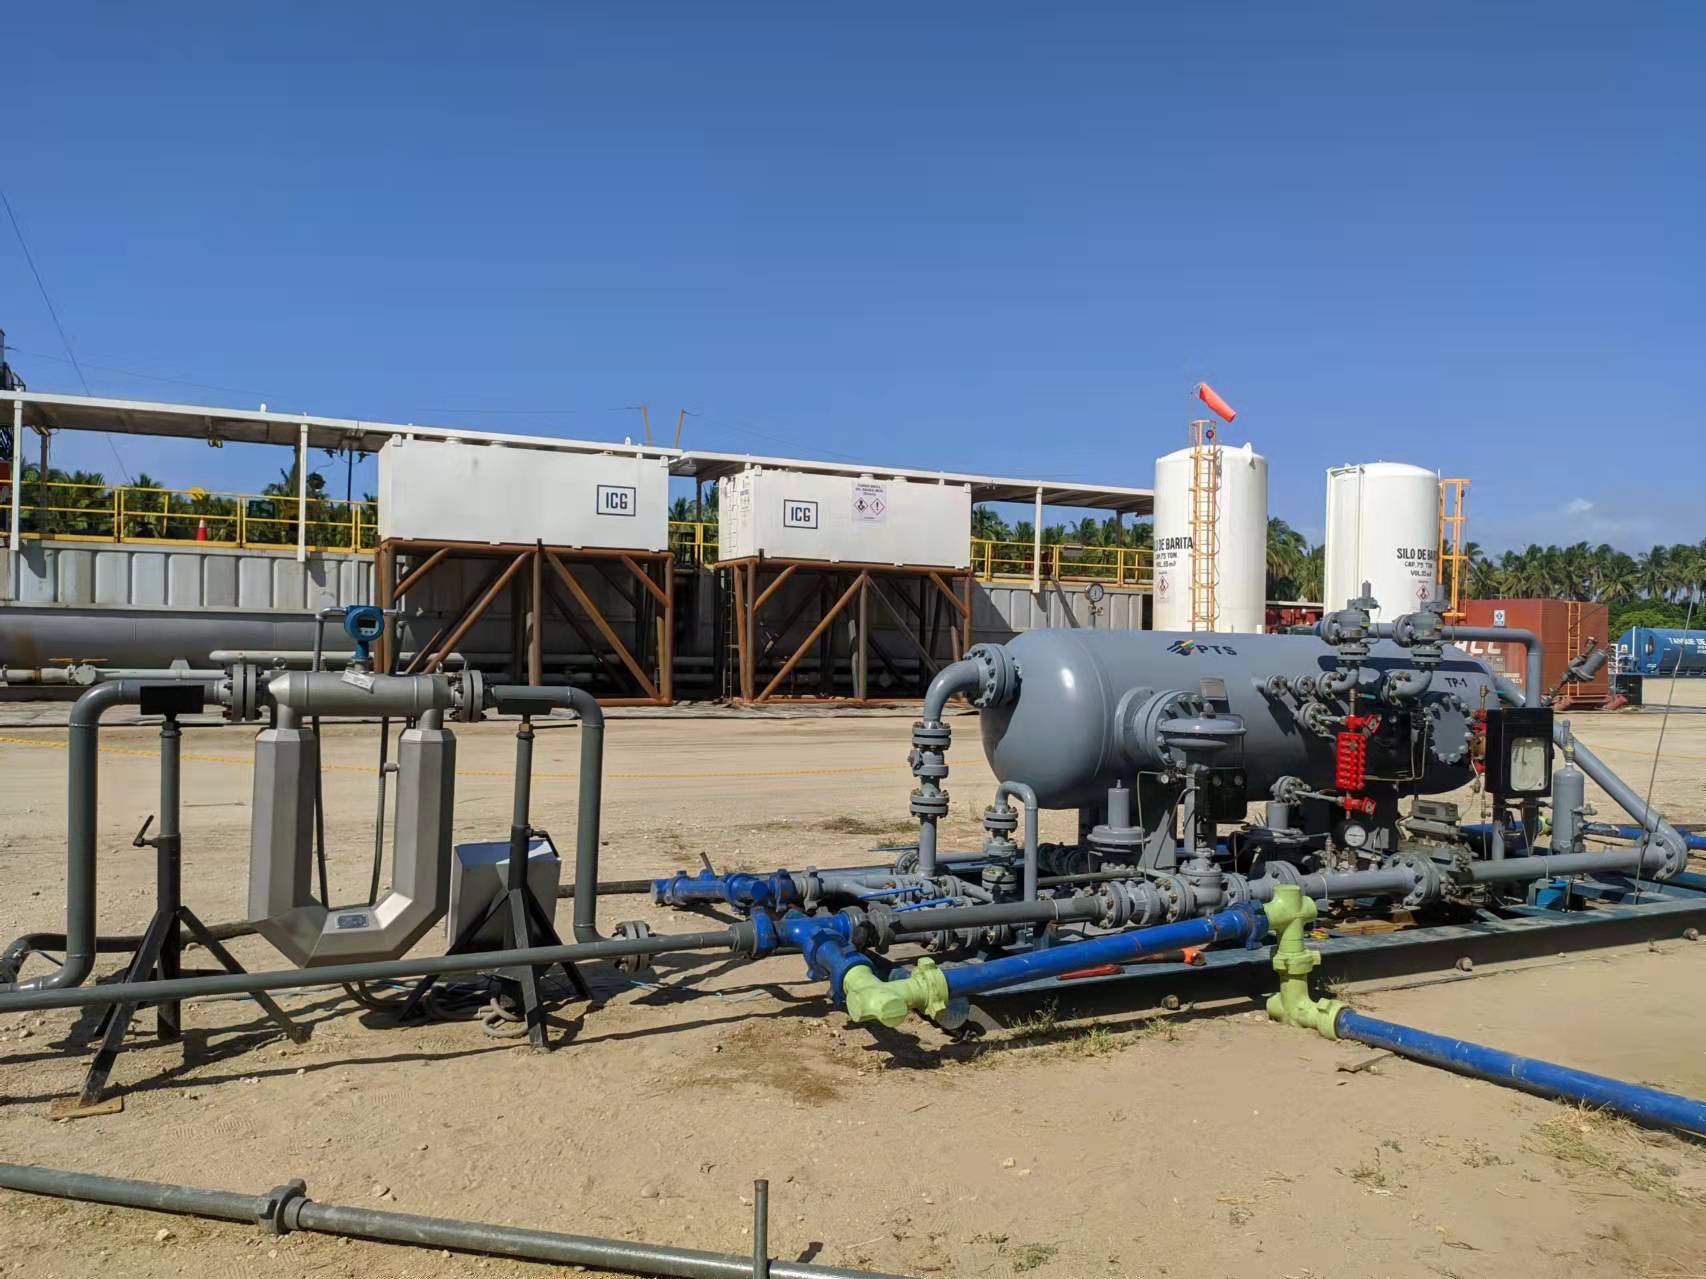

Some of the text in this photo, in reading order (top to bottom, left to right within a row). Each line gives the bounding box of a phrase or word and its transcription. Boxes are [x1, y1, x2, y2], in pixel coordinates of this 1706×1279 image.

[791, 506, 811, 522] ICG
[1166, 536, 1193, 551] BARITA
[1396, 547, 1416, 560] SILO
[1417, 549, 1427, 561] DE
[1195, 645, 1237, 656] PTS
[1445, 677, 1467, 688] TP-1
